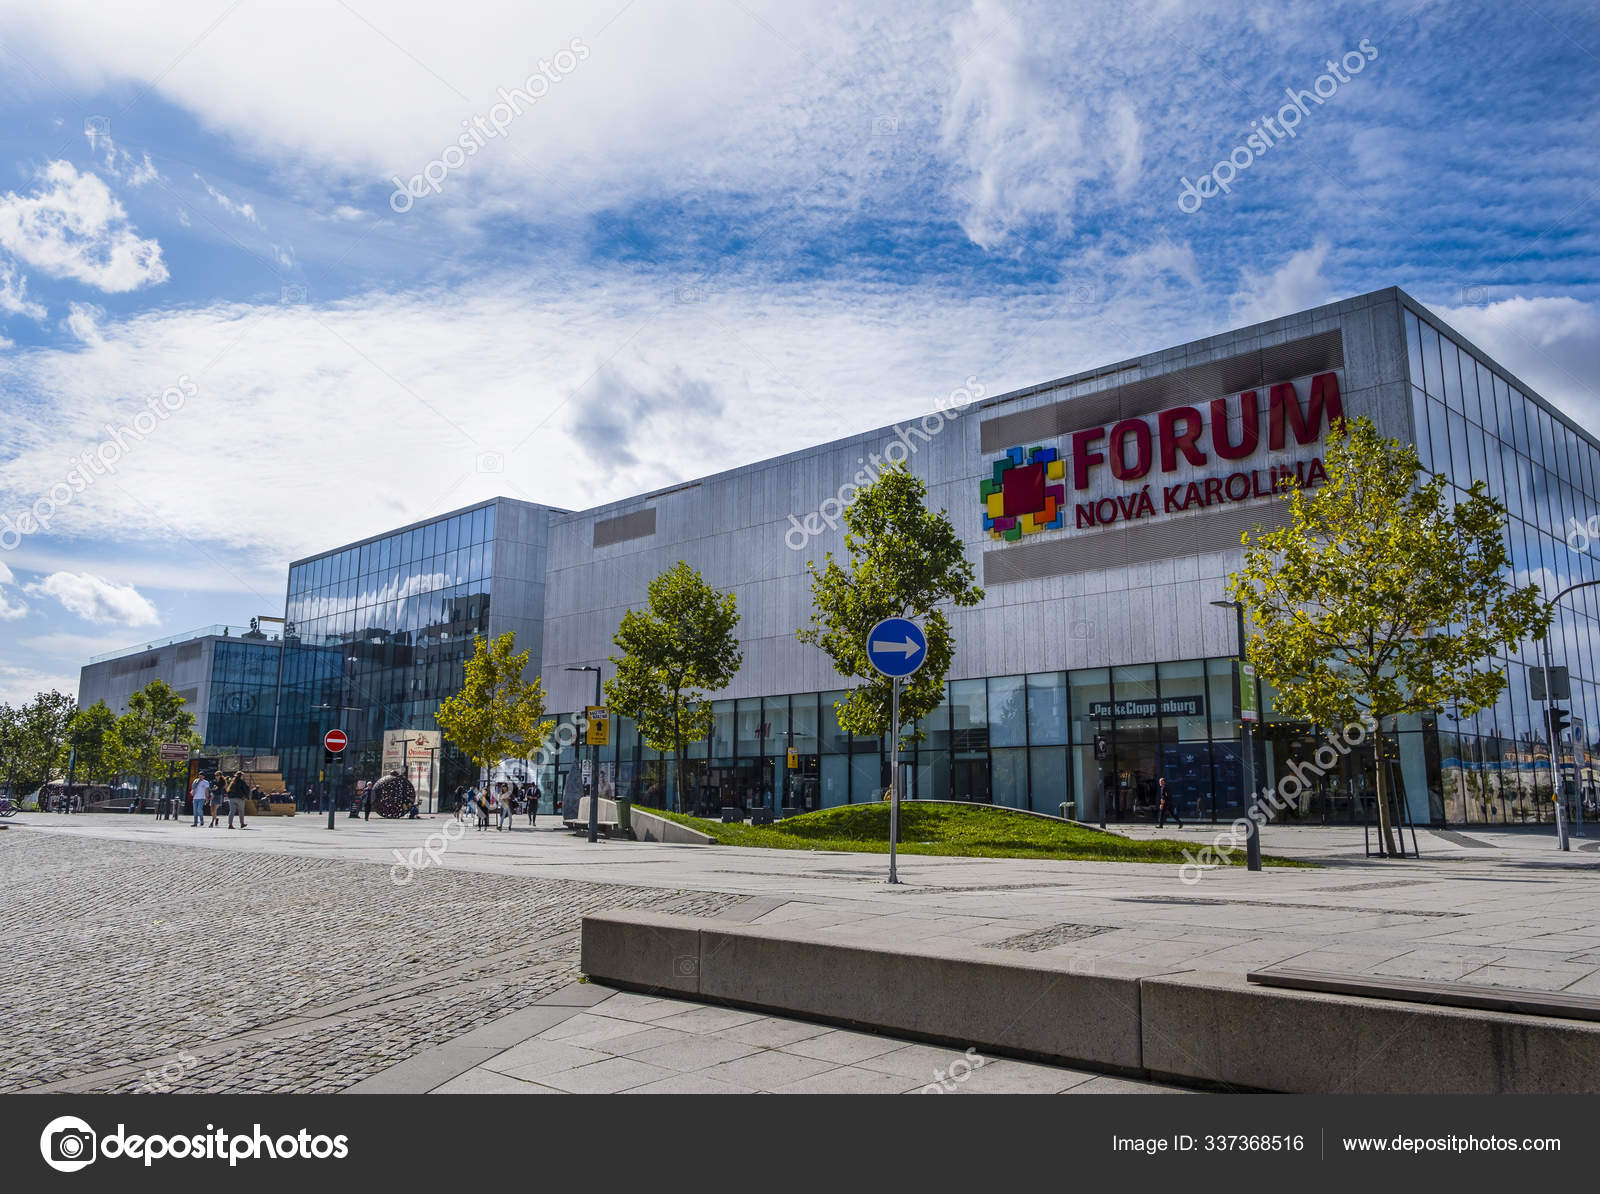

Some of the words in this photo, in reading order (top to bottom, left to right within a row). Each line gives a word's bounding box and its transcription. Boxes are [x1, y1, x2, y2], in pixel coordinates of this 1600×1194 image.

[1072, 372, 1347, 490] FORUM
[1075, 484, 1156, 529] NOVÁ
[1163, 457, 1329, 513] KAROLINA
[1094, 700, 1196, 716] Peek&Cloppnburg
